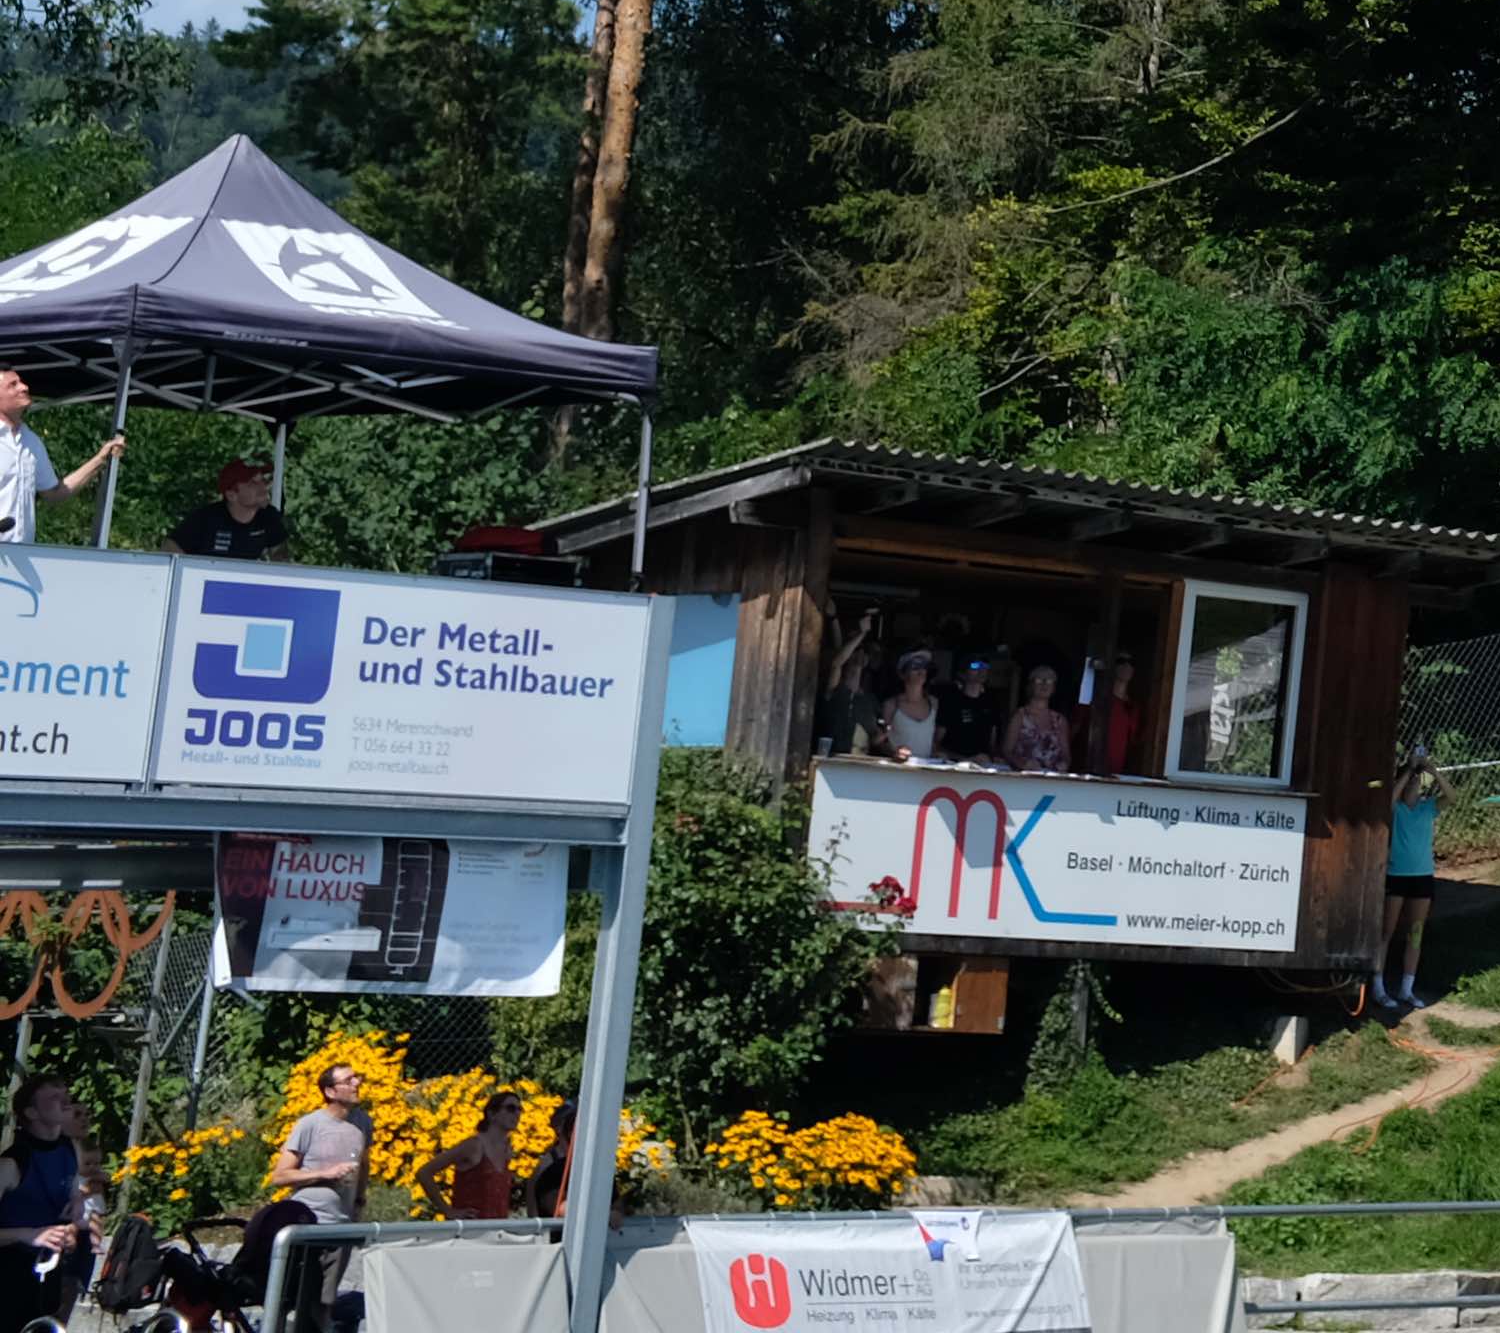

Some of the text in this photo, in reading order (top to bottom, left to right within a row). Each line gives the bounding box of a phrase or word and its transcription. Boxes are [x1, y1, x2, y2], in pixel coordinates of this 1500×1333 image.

[362, 615, 554, 657] Der Metall-
[358, 657, 614, 699] und Stahlbauer
[183, 708, 327, 751] JOOS
[234, 753, 259, 766] und
[1115, 800, 1296, 831] Lüftung Klima Kälte
[277, 851, 365, 875] HAUCH
[1066, 852, 1290, 884] Basel Mönchaltorf Zürich
[285, 877, 368, 903] LUXUS
[1126, 913, 1286, 939] www.meier-kopp.ch
[799, 1269, 898, 1297] Widmer
[806, 1307, 937, 1325] Heizung Klima Kälte
